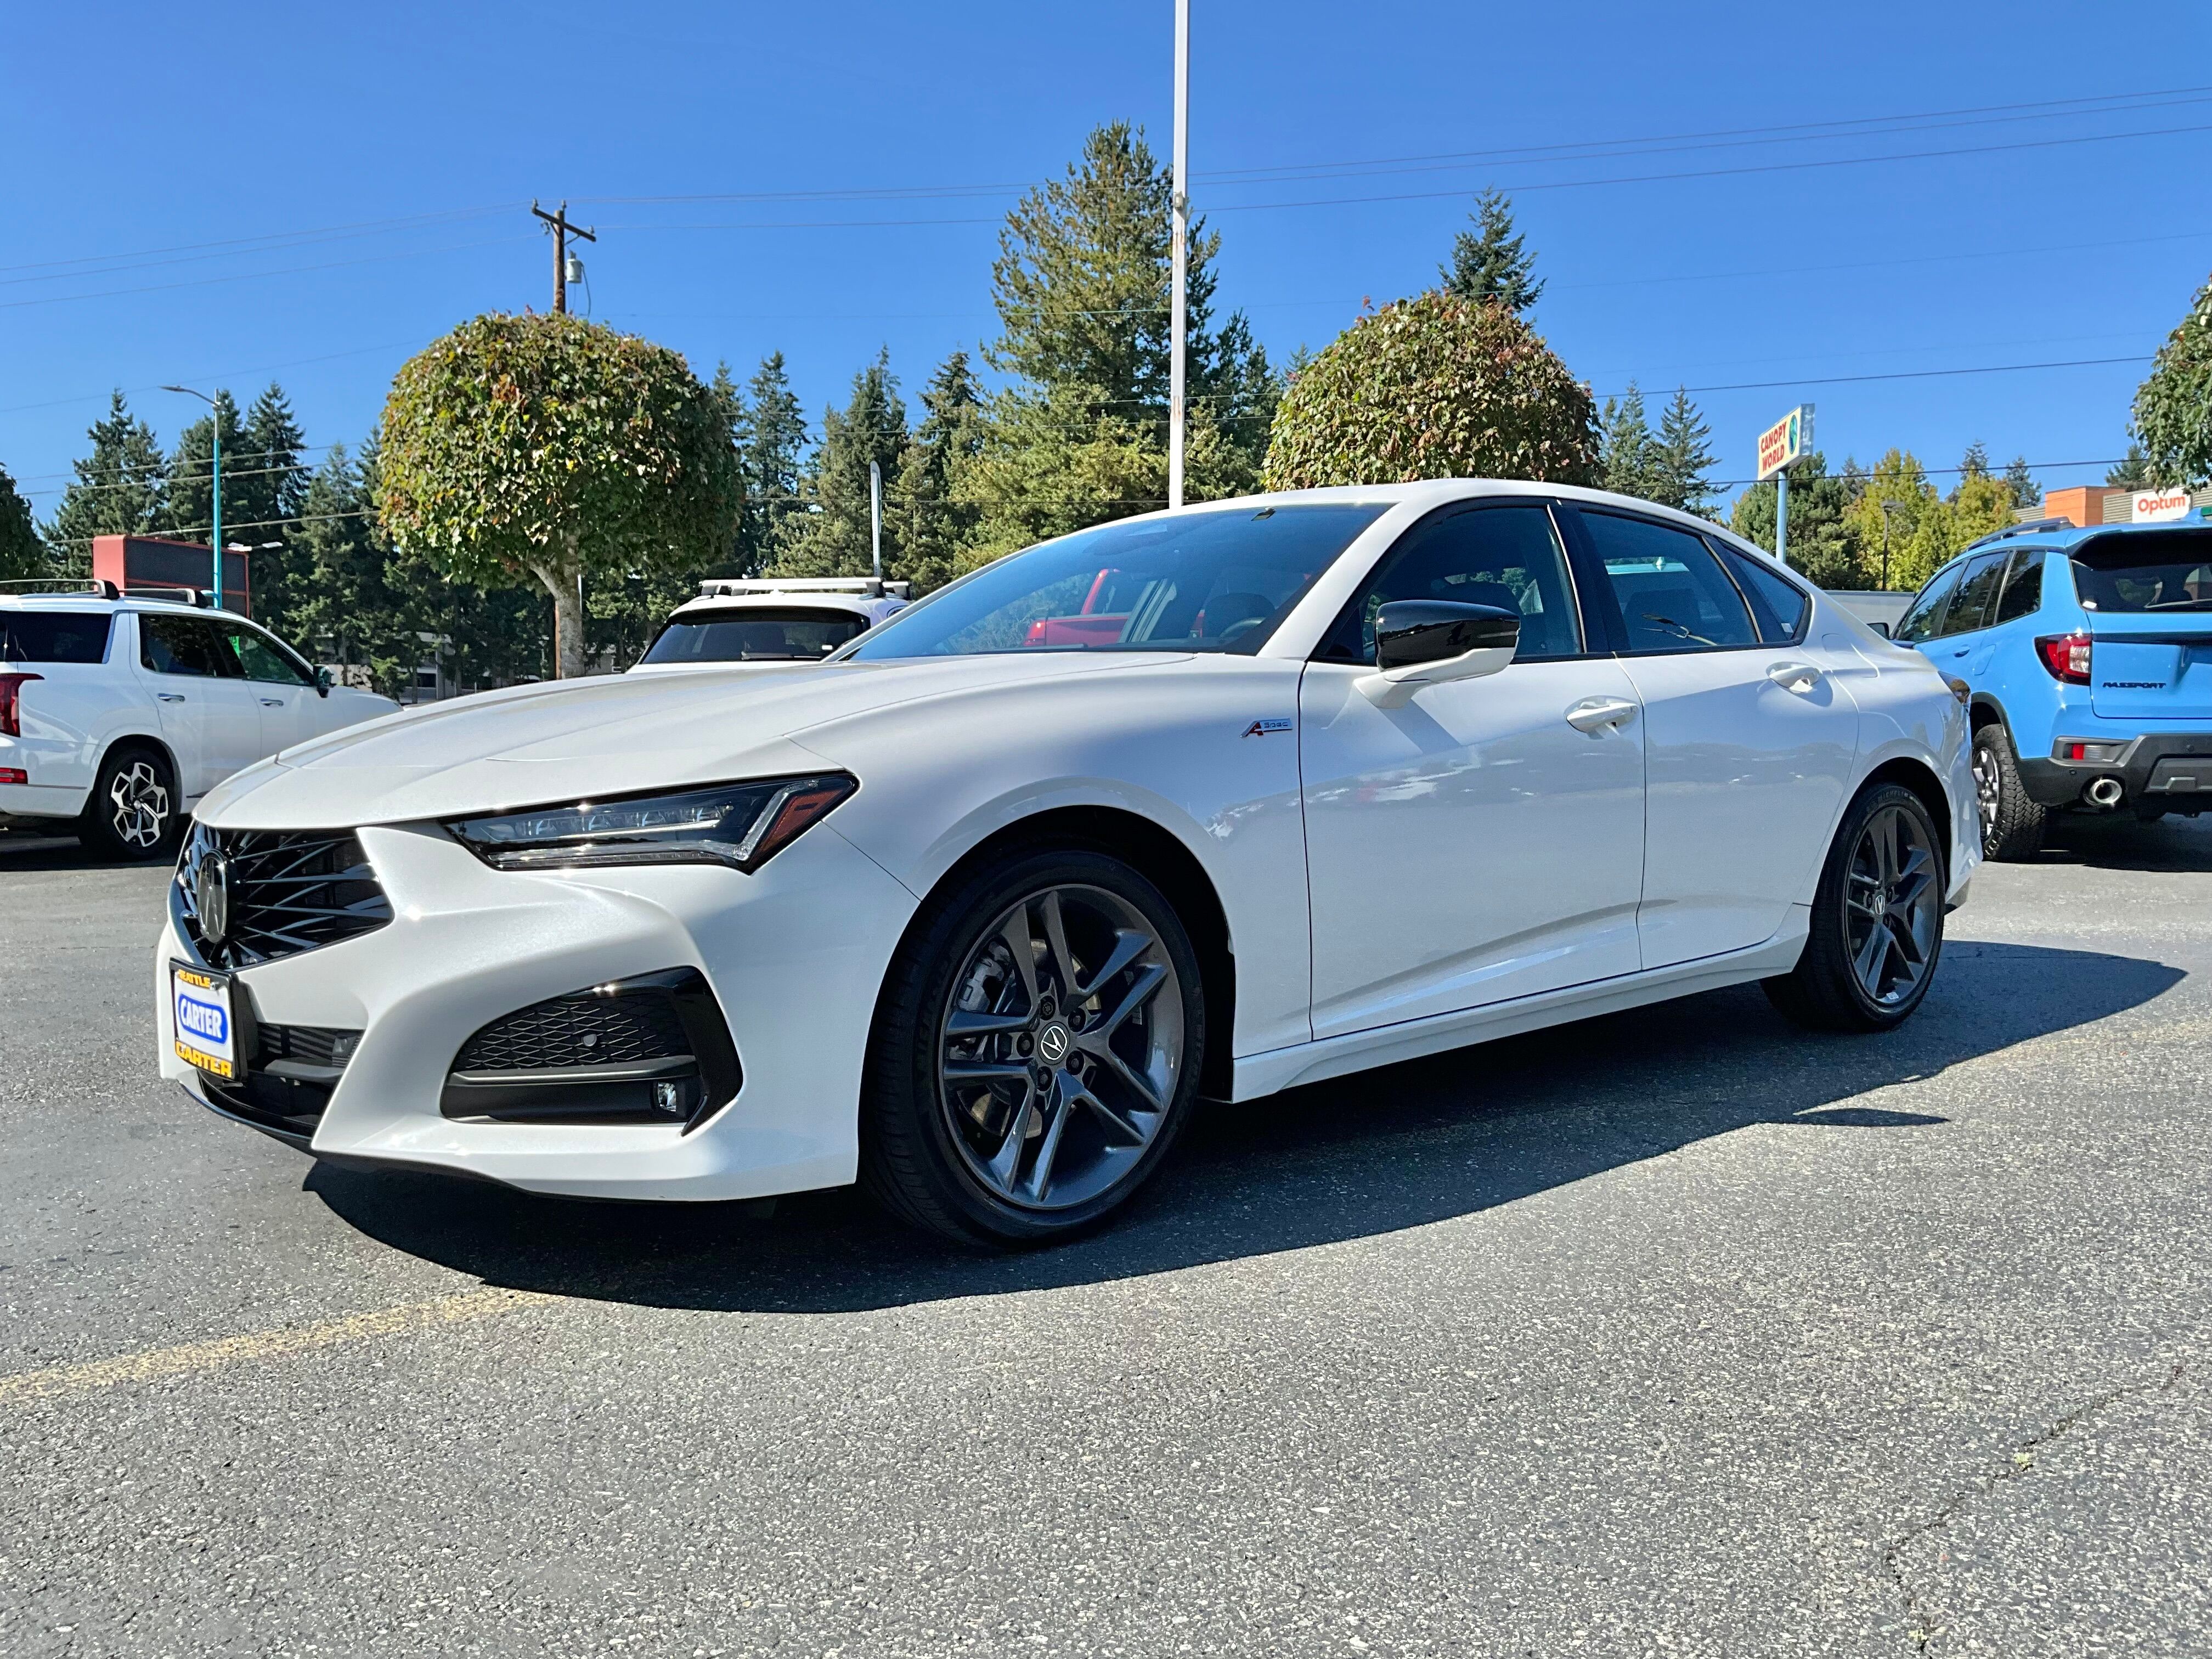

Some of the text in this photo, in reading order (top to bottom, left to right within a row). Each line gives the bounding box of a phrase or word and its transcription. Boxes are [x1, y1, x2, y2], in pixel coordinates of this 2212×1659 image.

[1761, 421, 1787, 453] CANOPY
[1762, 444, 1785, 472] WORLD
[2138, 496, 2186, 515] Optum
[180, 998, 222, 1039] CARTER
[176, 1041, 233, 1078] CARTER
